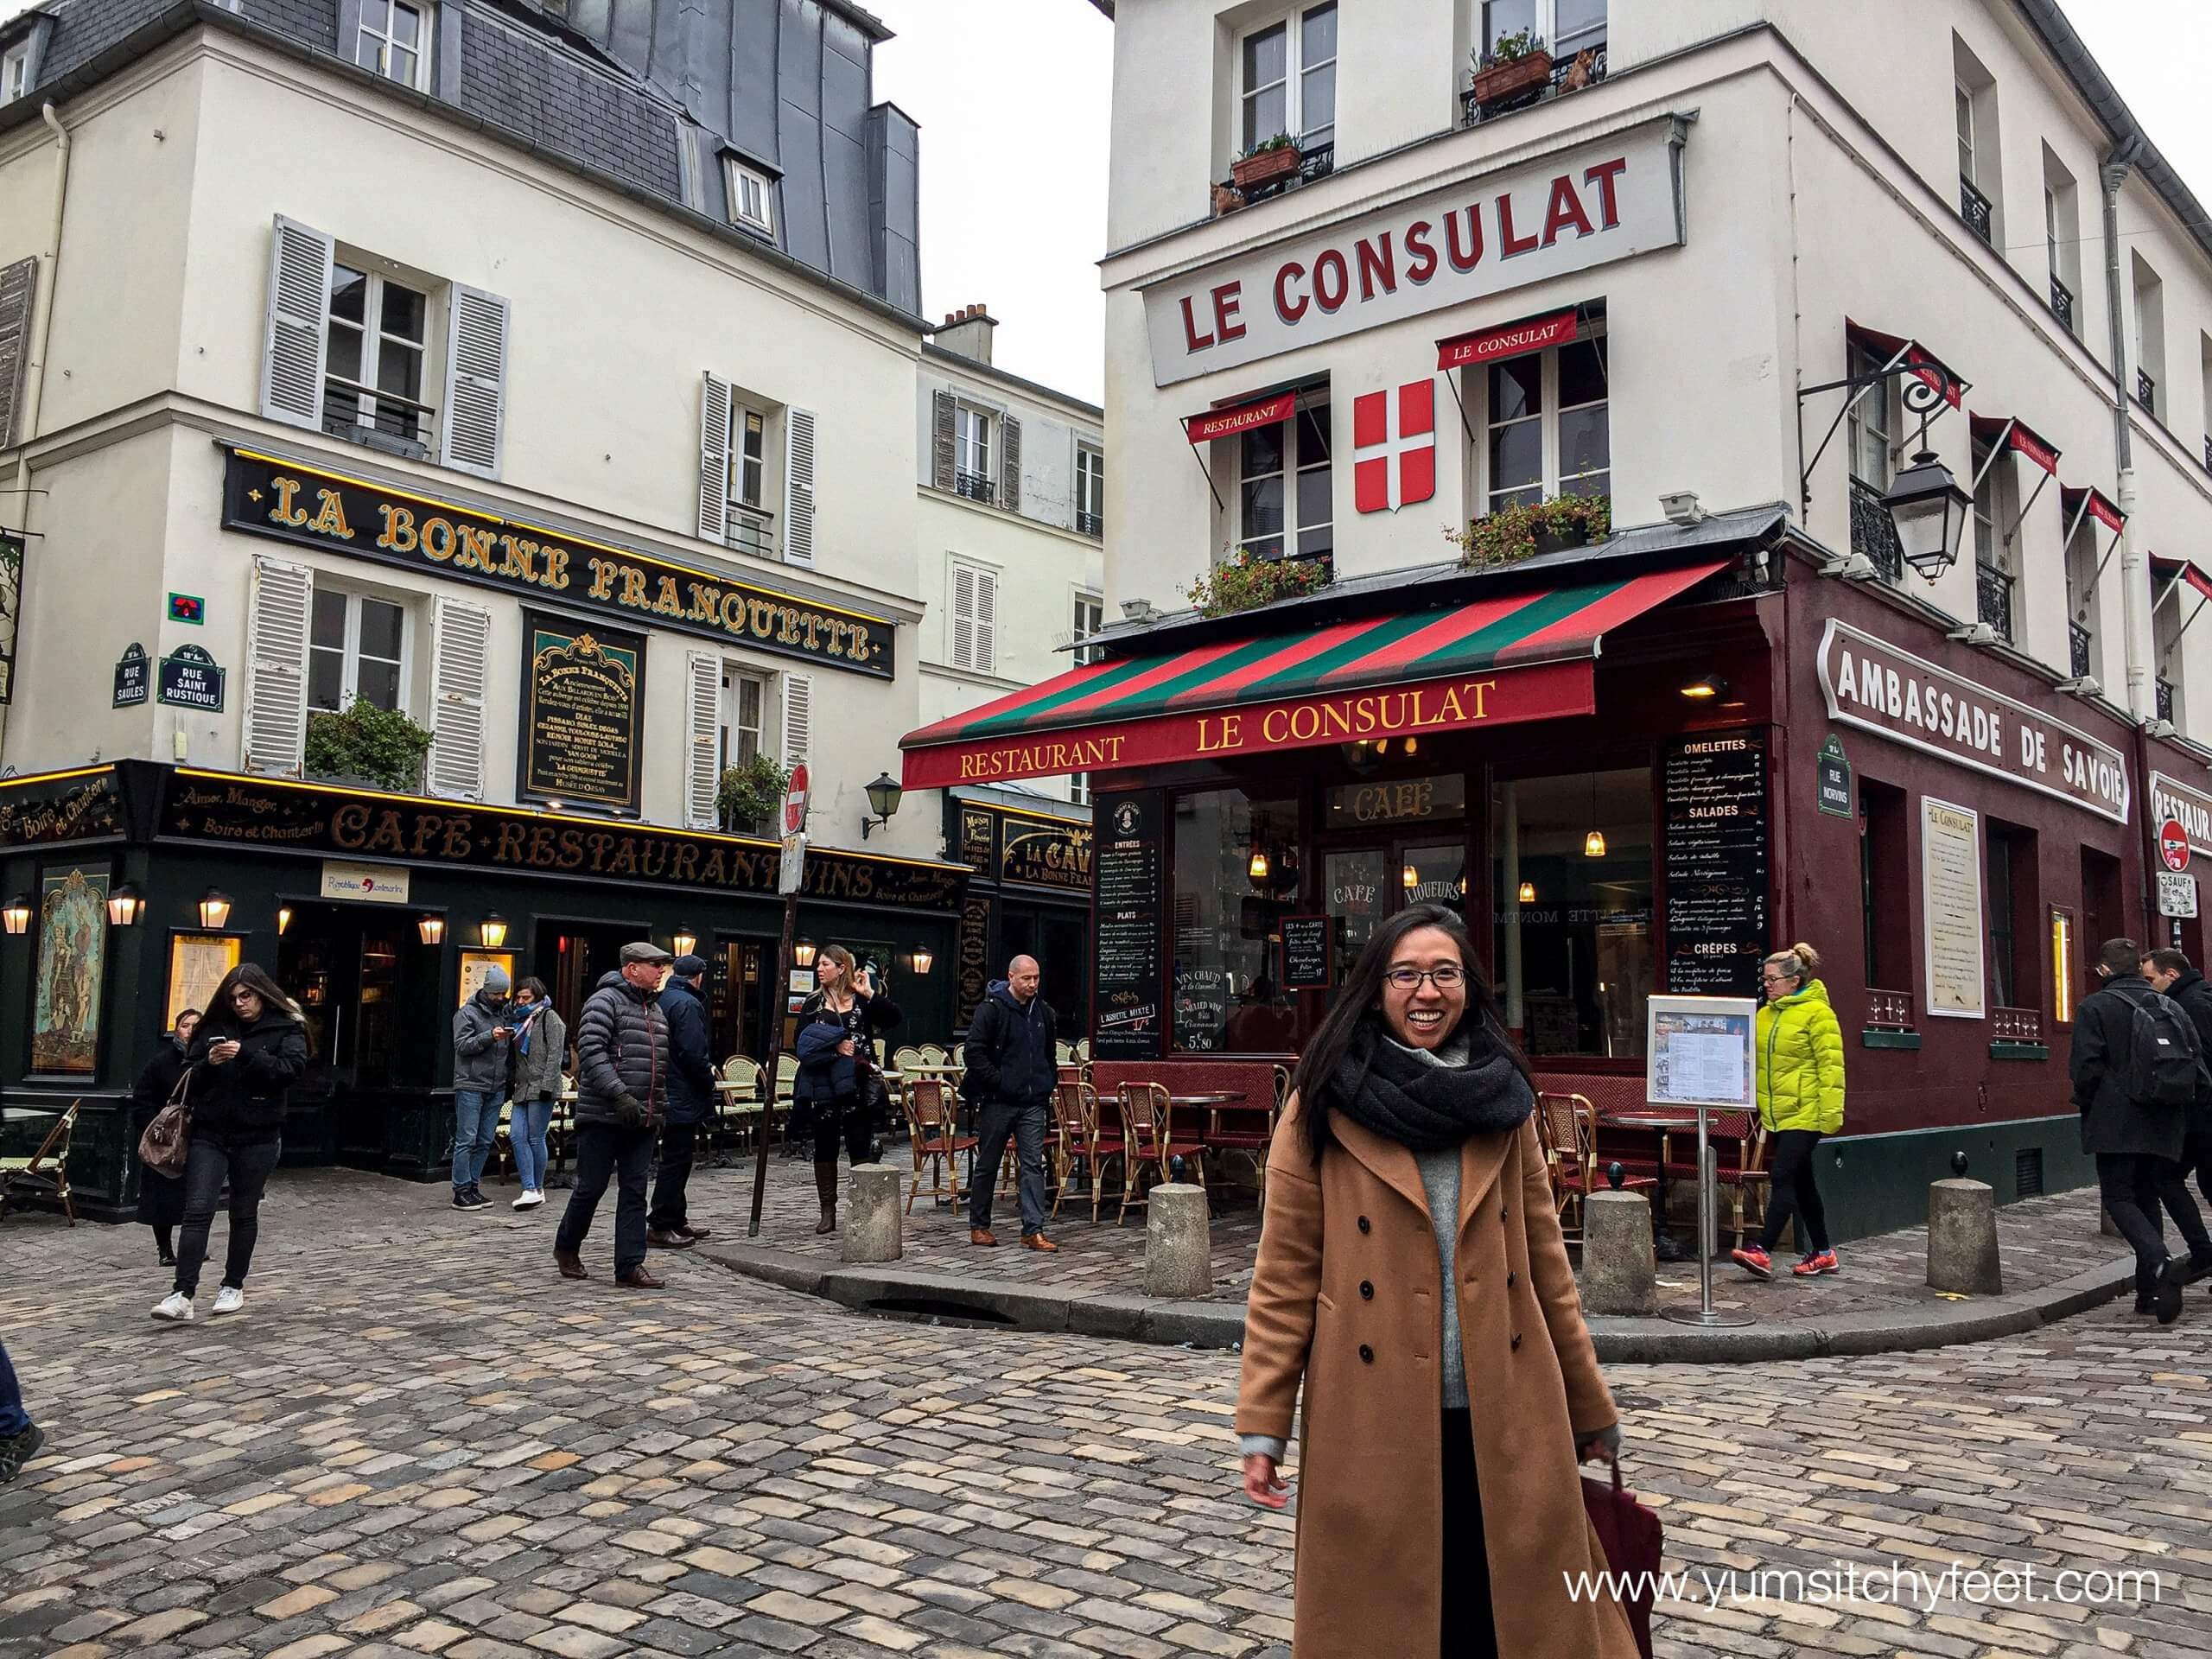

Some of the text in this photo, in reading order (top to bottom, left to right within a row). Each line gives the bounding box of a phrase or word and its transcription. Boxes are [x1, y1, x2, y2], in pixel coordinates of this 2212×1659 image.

[1179, 156, 1627, 355] LE CONSULAT
[1453, 323, 1558, 361] LE CONSULAT
[1203, 404, 1278, 435] RESTAURANT
[269, 475, 869, 662] LA BONNE FRANQUETTE
[124, 666, 140, 679] RUE
[182, 667, 203, 680] RUE
[117, 685, 145, 700] SAULES
[177, 678, 207, 692] SAINT
[166, 688, 216, 705] RUSTIQUE
[960, 680, 1496, 779] RESTAURANT LE CONSULAT
[1838, 650, 2123, 807] AMBASSADE DE SAVOIE
[1684, 739, 1746, 754] OMELETTES
[1829, 769, 1841, 784] RUE
[1823, 785, 1847, 804] NORVINS
[1688, 804, 1739, 818] SALADES
[2154, 788, 2212, 842] RESTAUR
[22, 808, 56, 840] Boire
[1940, 810, 1972, 833] CONSULAT
[332, 804, 473, 859] CAFÉ
[491, 821, 781, 891] RESTAURANT
[1115, 840, 1141, 849] ENTRÉES
[1027, 842, 1092, 873] LA CAV
[1025, 864, 1039, 879] LA
[1040, 867, 1069, 882] BONNE
[2168, 875, 2188, 887] SAUF
[1404, 880, 1462, 905] LIQUEURS
[1694, 941, 1738, 955] CRÊPES
[1175, 970, 1221, 985] VIN CHAUD
[1129, 1006, 1150, 1018] MIXTE
